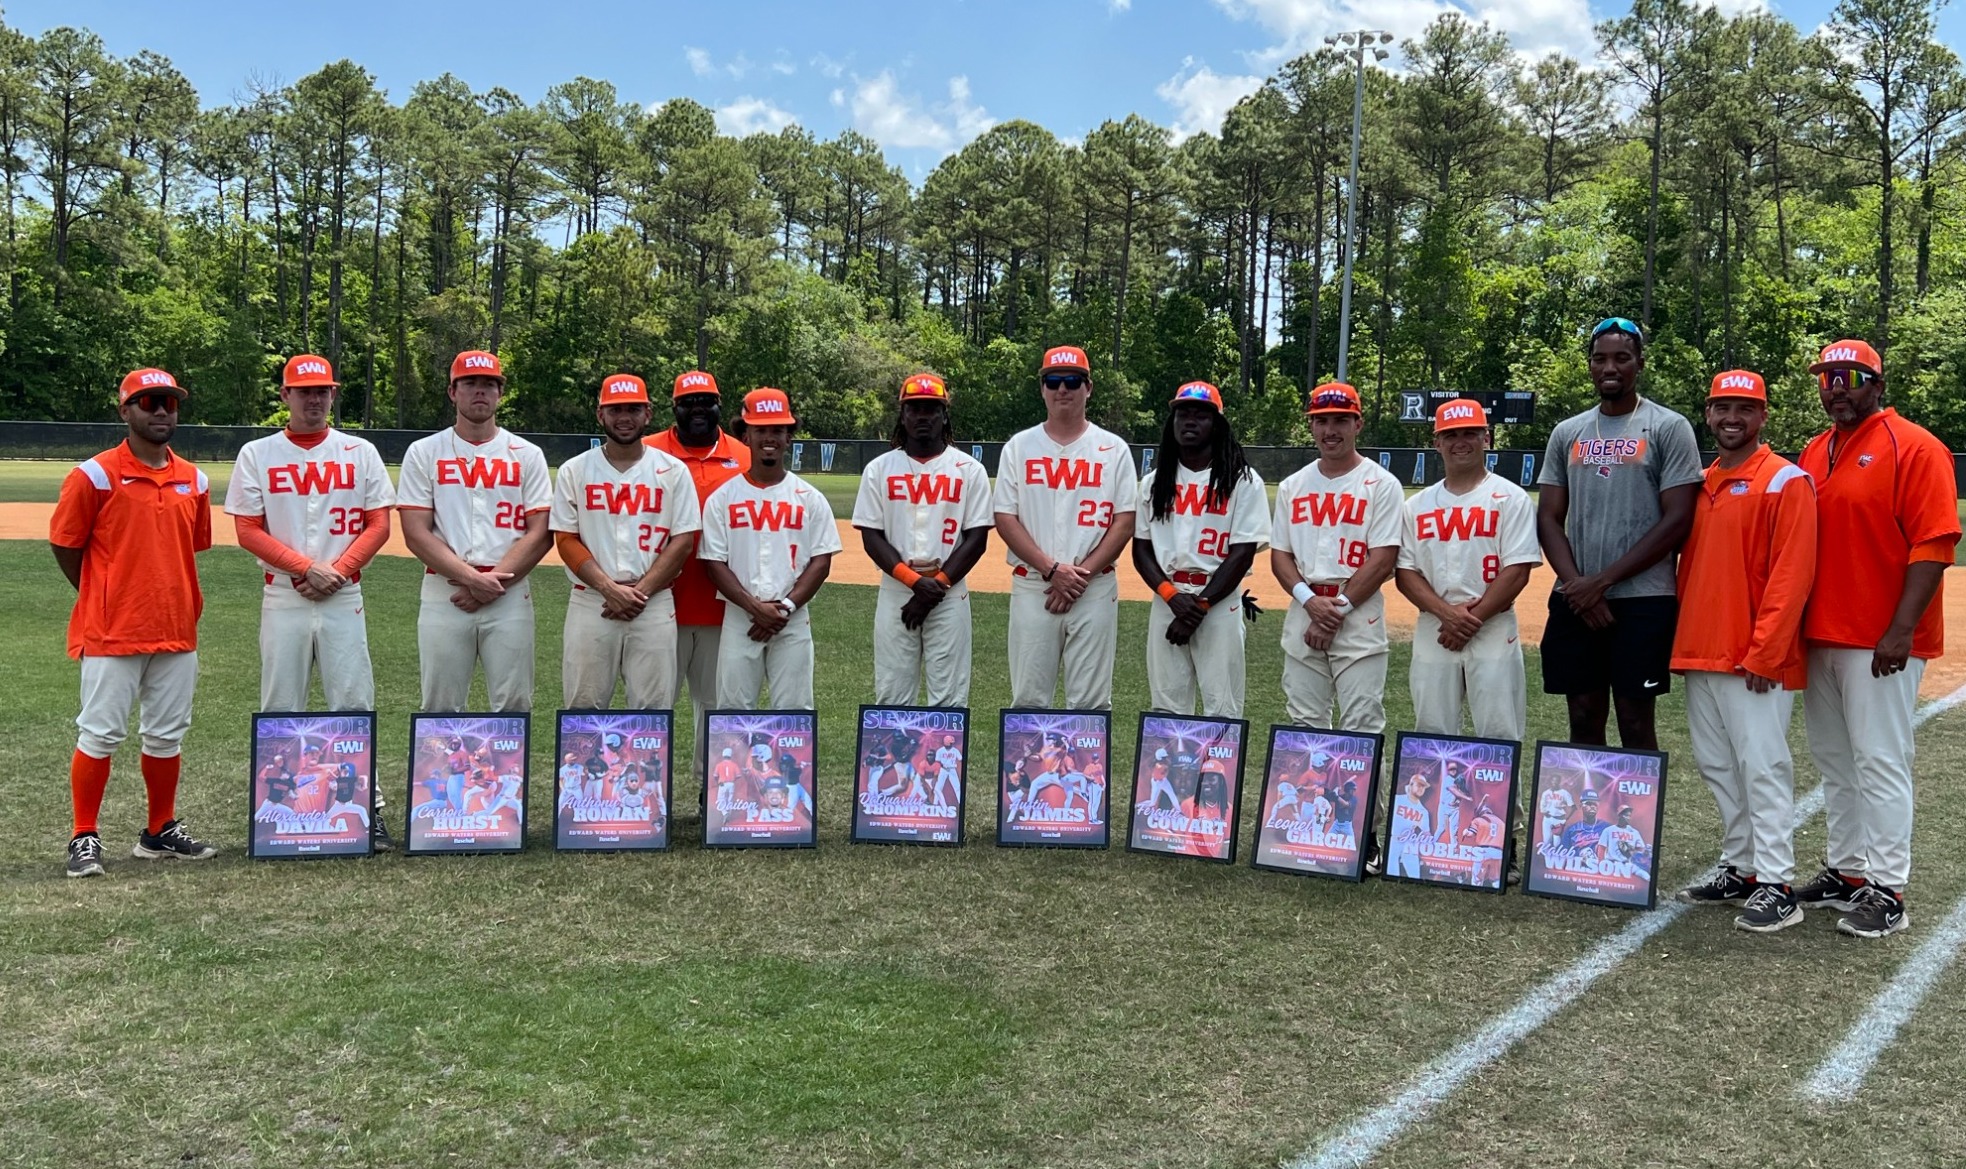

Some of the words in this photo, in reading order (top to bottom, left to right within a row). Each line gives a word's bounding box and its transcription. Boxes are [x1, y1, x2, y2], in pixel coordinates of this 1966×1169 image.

[1050, 352, 1078, 365] EWU
[1825, 347, 1857, 361] EWU
[297, 361, 326, 375] EWU
[465, 357, 494, 369] EWU
[140, 374, 173, 387] EWU
[610, 381, 638, 394] EWU
[682, 376, 709, 388] EWU
[1720, 375, 1754, 390] EWU
[1430, 391, 1460, 399] VISITOR
[756, 400, 783, 413] EWU
[1400, 393, 1426, 420] R
[1443, 405, 1474, 420] EWU
[1578, 438, 1639, 457] TIGERS
[1583, 456, 1624, 465] BASEBALL
[268, 461, 356, 496] EWU
[437, 456, 521, 489] EWU
[1025, 456, 1103, 490] EWU
[887, 473, 963, 505] EWU
[584, 483, 664, 515] EWU
[1168, 483, 1229, 516] WU
[495, 501, 527, 530] 28
[728, 500, 805, 532] EWU
[1077, 500, 1114, 529] 23
[1291, 492, 1368, 526] EWU
[329, 507, 364, 536] 32
[1416, 506, 1500, 542] EWU
[638, 524, 670, 554] 27
[941, 518, 957, 545] 2
[1198, 528, 1230, 558] 20
[790, 544, 798, 570] 1
[1338, 537, 1368, 568] 18
[1482, 554, 1499, 583] 8
[334, 741, 364, 754] EWU
[494, 740, 519, 751] EWU
[633, 737, 662, 749] EWU
[778, 737, 803, 748] EWU
[1077, 737, 1101, 748] EWU
[1208, 746, 1233, 759] EWU
[1340, 759, 1366, 771] EWU
[1475, 769, 1504, 782] EWU
[1618, 780, 1651, 795] EWU
[259, 809, 327, 823] Alexander
[573, 807, 651, 822] ROMAN
[746, 809, 794, 822] PASS
[863, 804, 957, 818] THOMPKINS
[1019, 808, 1085, 822] JAMES
[276, 818, 348, 834] DAVILA
[432, 815, 502, 830] HURST
[1147, 815, 1228, 836] COWART
[1286, 829, 1357, 851] GARCIA
[1544, 856, 1634, 879] WILSON
